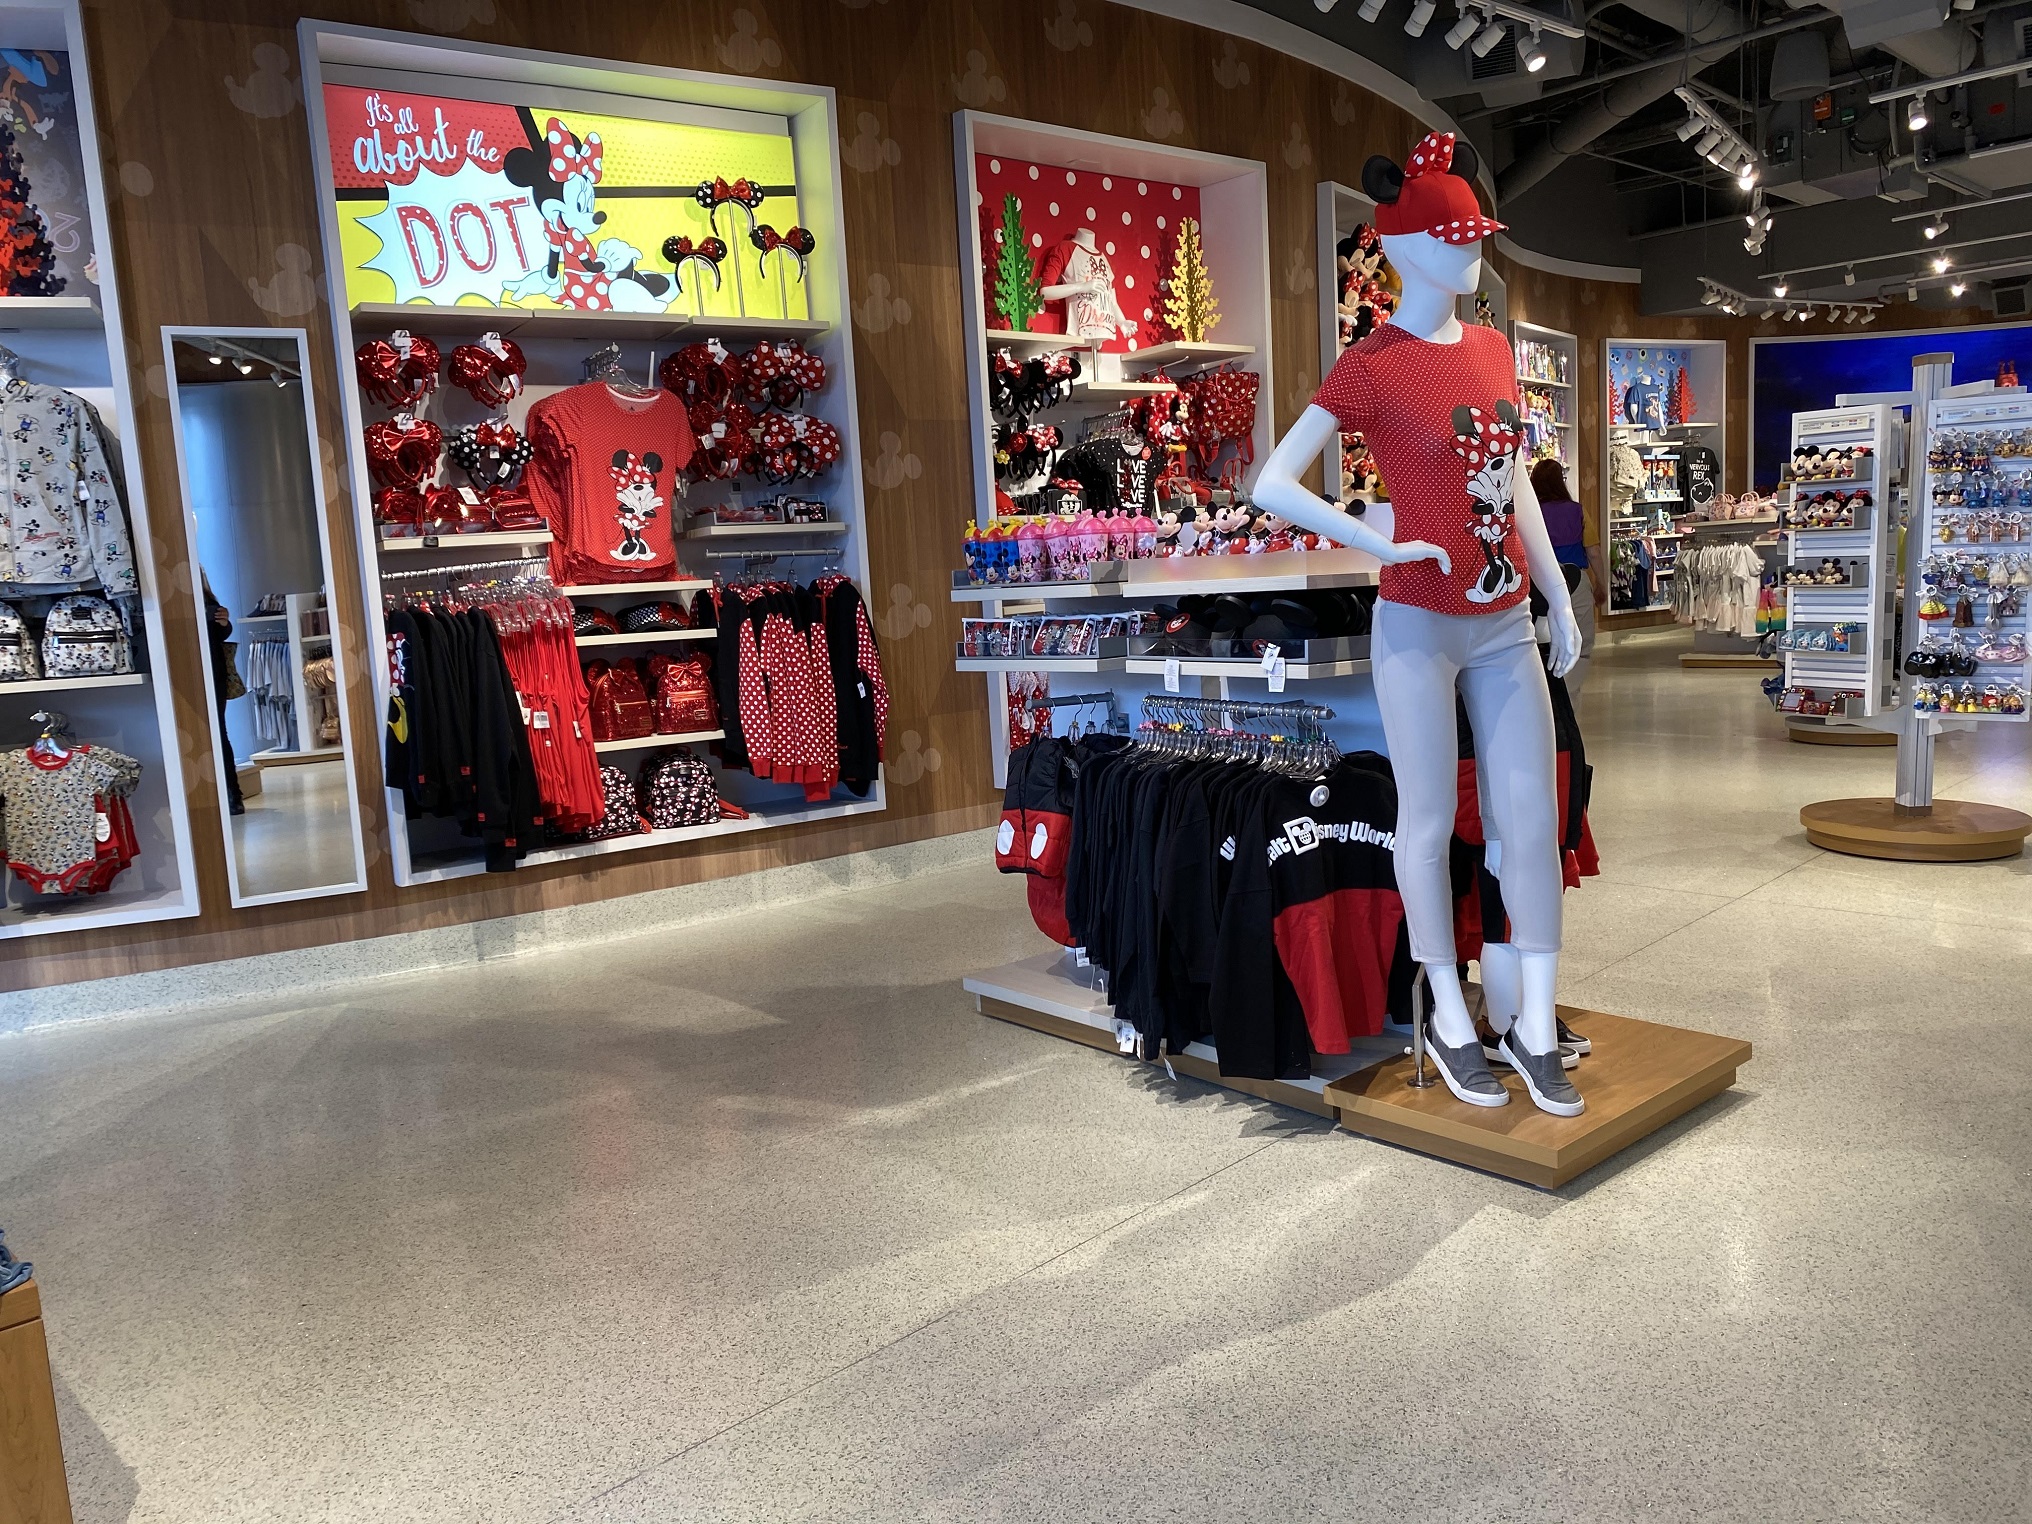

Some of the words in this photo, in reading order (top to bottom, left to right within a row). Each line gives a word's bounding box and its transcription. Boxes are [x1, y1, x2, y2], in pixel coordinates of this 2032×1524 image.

[365, 93, 393, 127] It's
[393, 107, 419, 134] all
[353, 107, 457, 174] about
[466, 129, 500, 162] the
[394, 195, 531, 289] DOT
[1692, 471, 1705, 480] REX
[1267, 836, 1292, 868] alt
